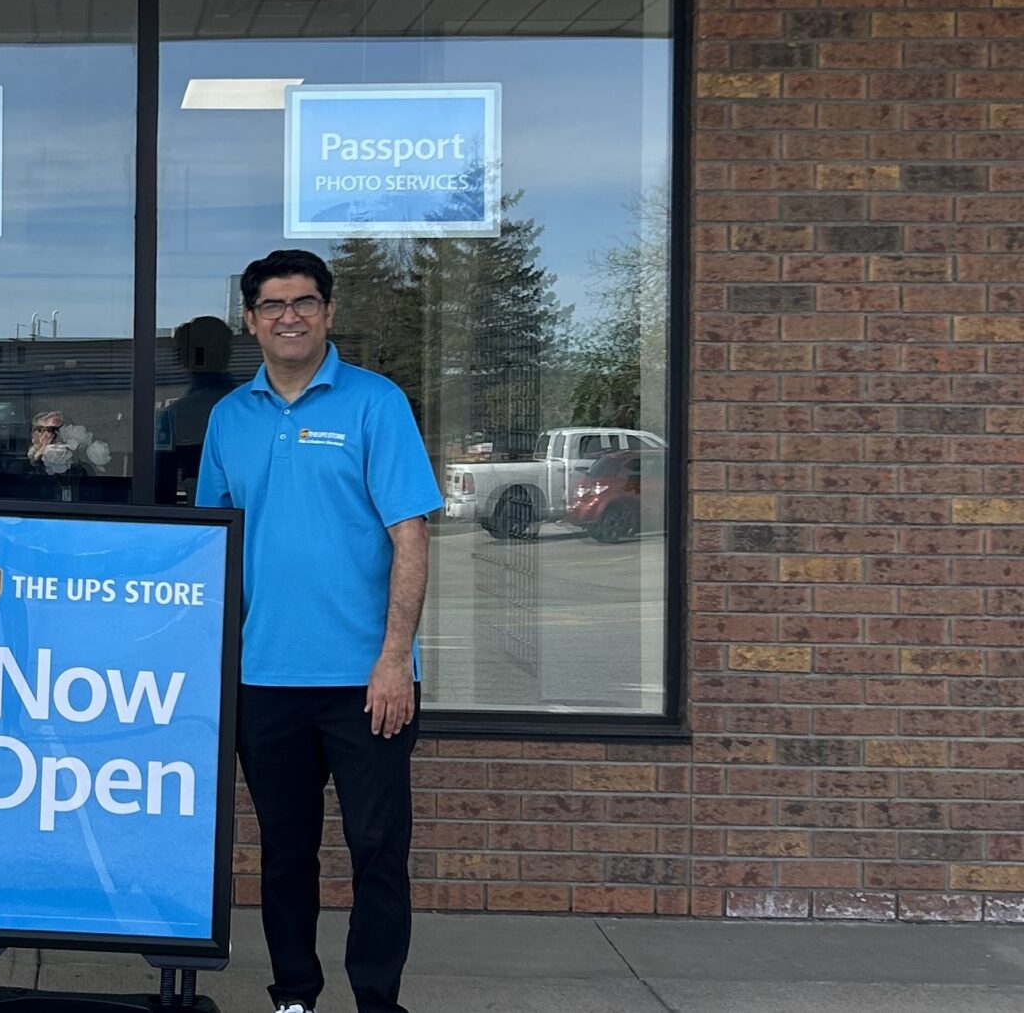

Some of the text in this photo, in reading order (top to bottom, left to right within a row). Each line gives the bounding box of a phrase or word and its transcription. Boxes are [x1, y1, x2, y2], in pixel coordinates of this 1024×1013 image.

[321, 132, 465, 168] Passport
[315, 174, 470, 191] PHOTO SERVICES
[12, 575, 204, 606] THE UPS STORE
